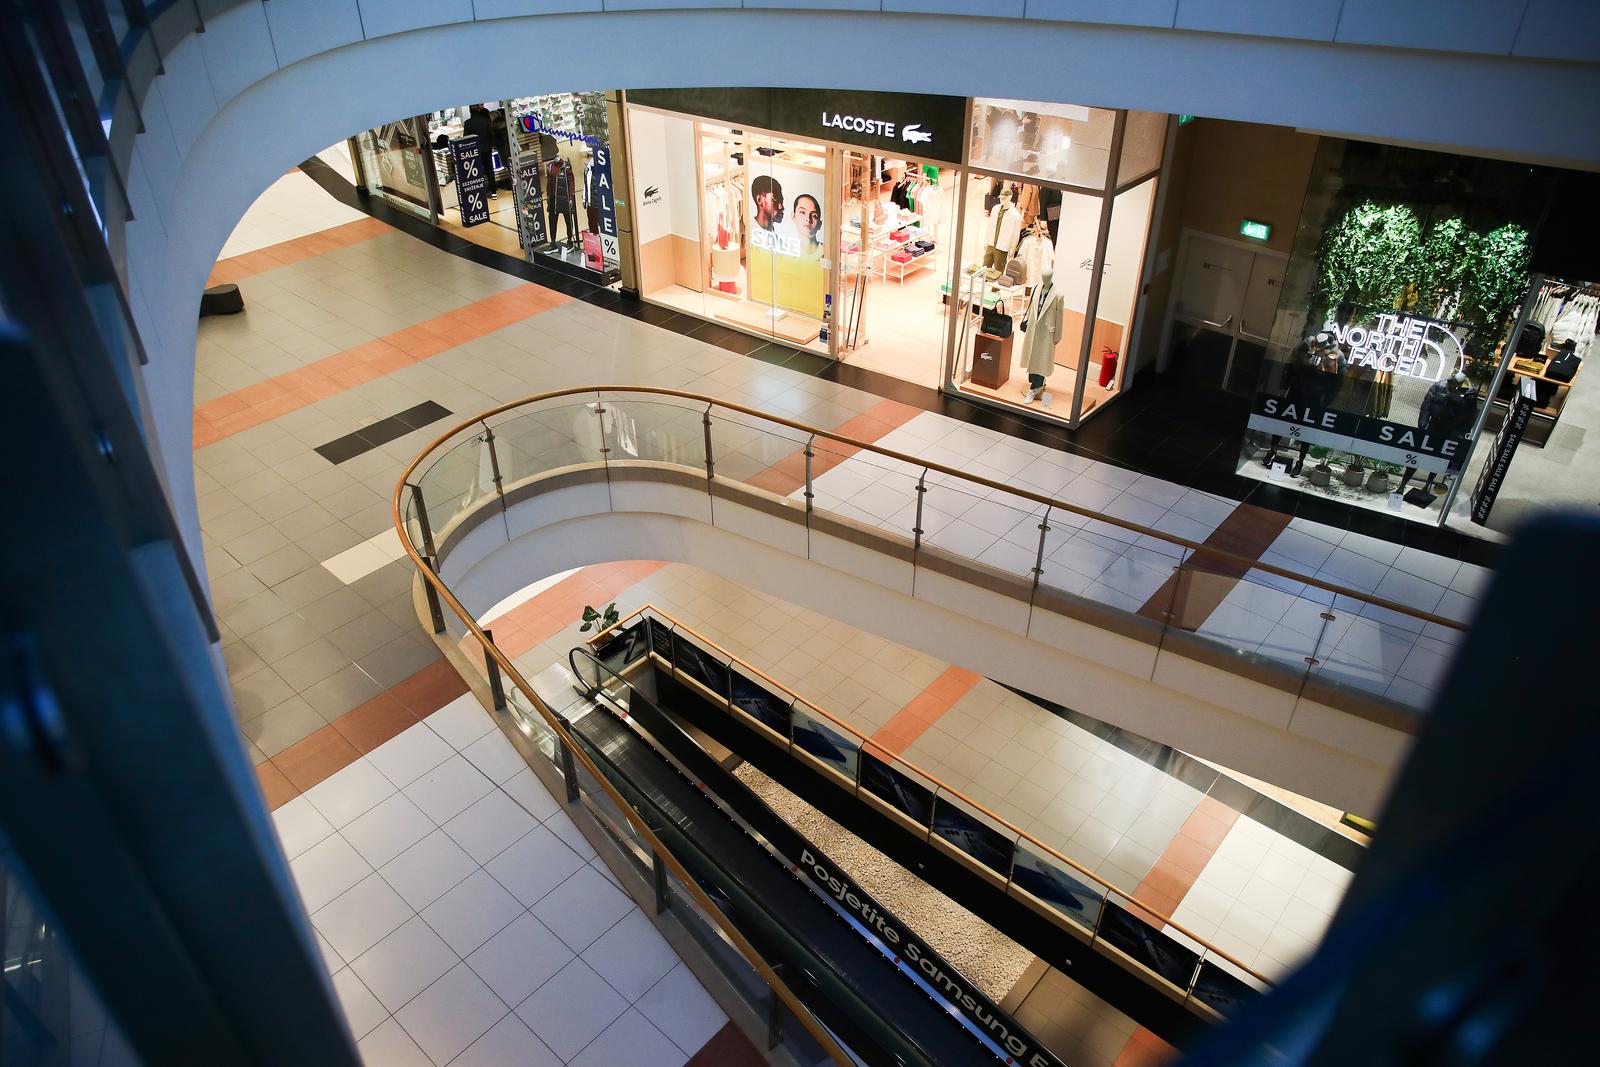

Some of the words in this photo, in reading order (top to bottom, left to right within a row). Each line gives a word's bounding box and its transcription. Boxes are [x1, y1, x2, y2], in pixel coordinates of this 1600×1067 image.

[523, 114, 600, 147] Champion
[822, 111, 895, 138] LACOSTE
[460, 149, 479, 160] SALE
[597, 150, 613, 233] SALE
[469, 212, 488, 223] SALE
[530, 232, 546, 244] ALE
[604, 239, 616, 255] %
[751, 228, 801, 257] SALE
[1332, 322, 1421, 358] NORTH
[1376, 313, 1427, 340] THE
[1348, 346, 1415, 375] FACE
[1264, 399, 1338, 428] SALE
[1379, 425, 1459, 456] SALE
[1506, 433, 1517, 449] SALE
[1500, 448, 1511, 463] SALE
[1488, 477, 1498, 492] SALE
[801, 849, 900, 944] Posjetite
[903, 943, 1028, 1057] Samsung
